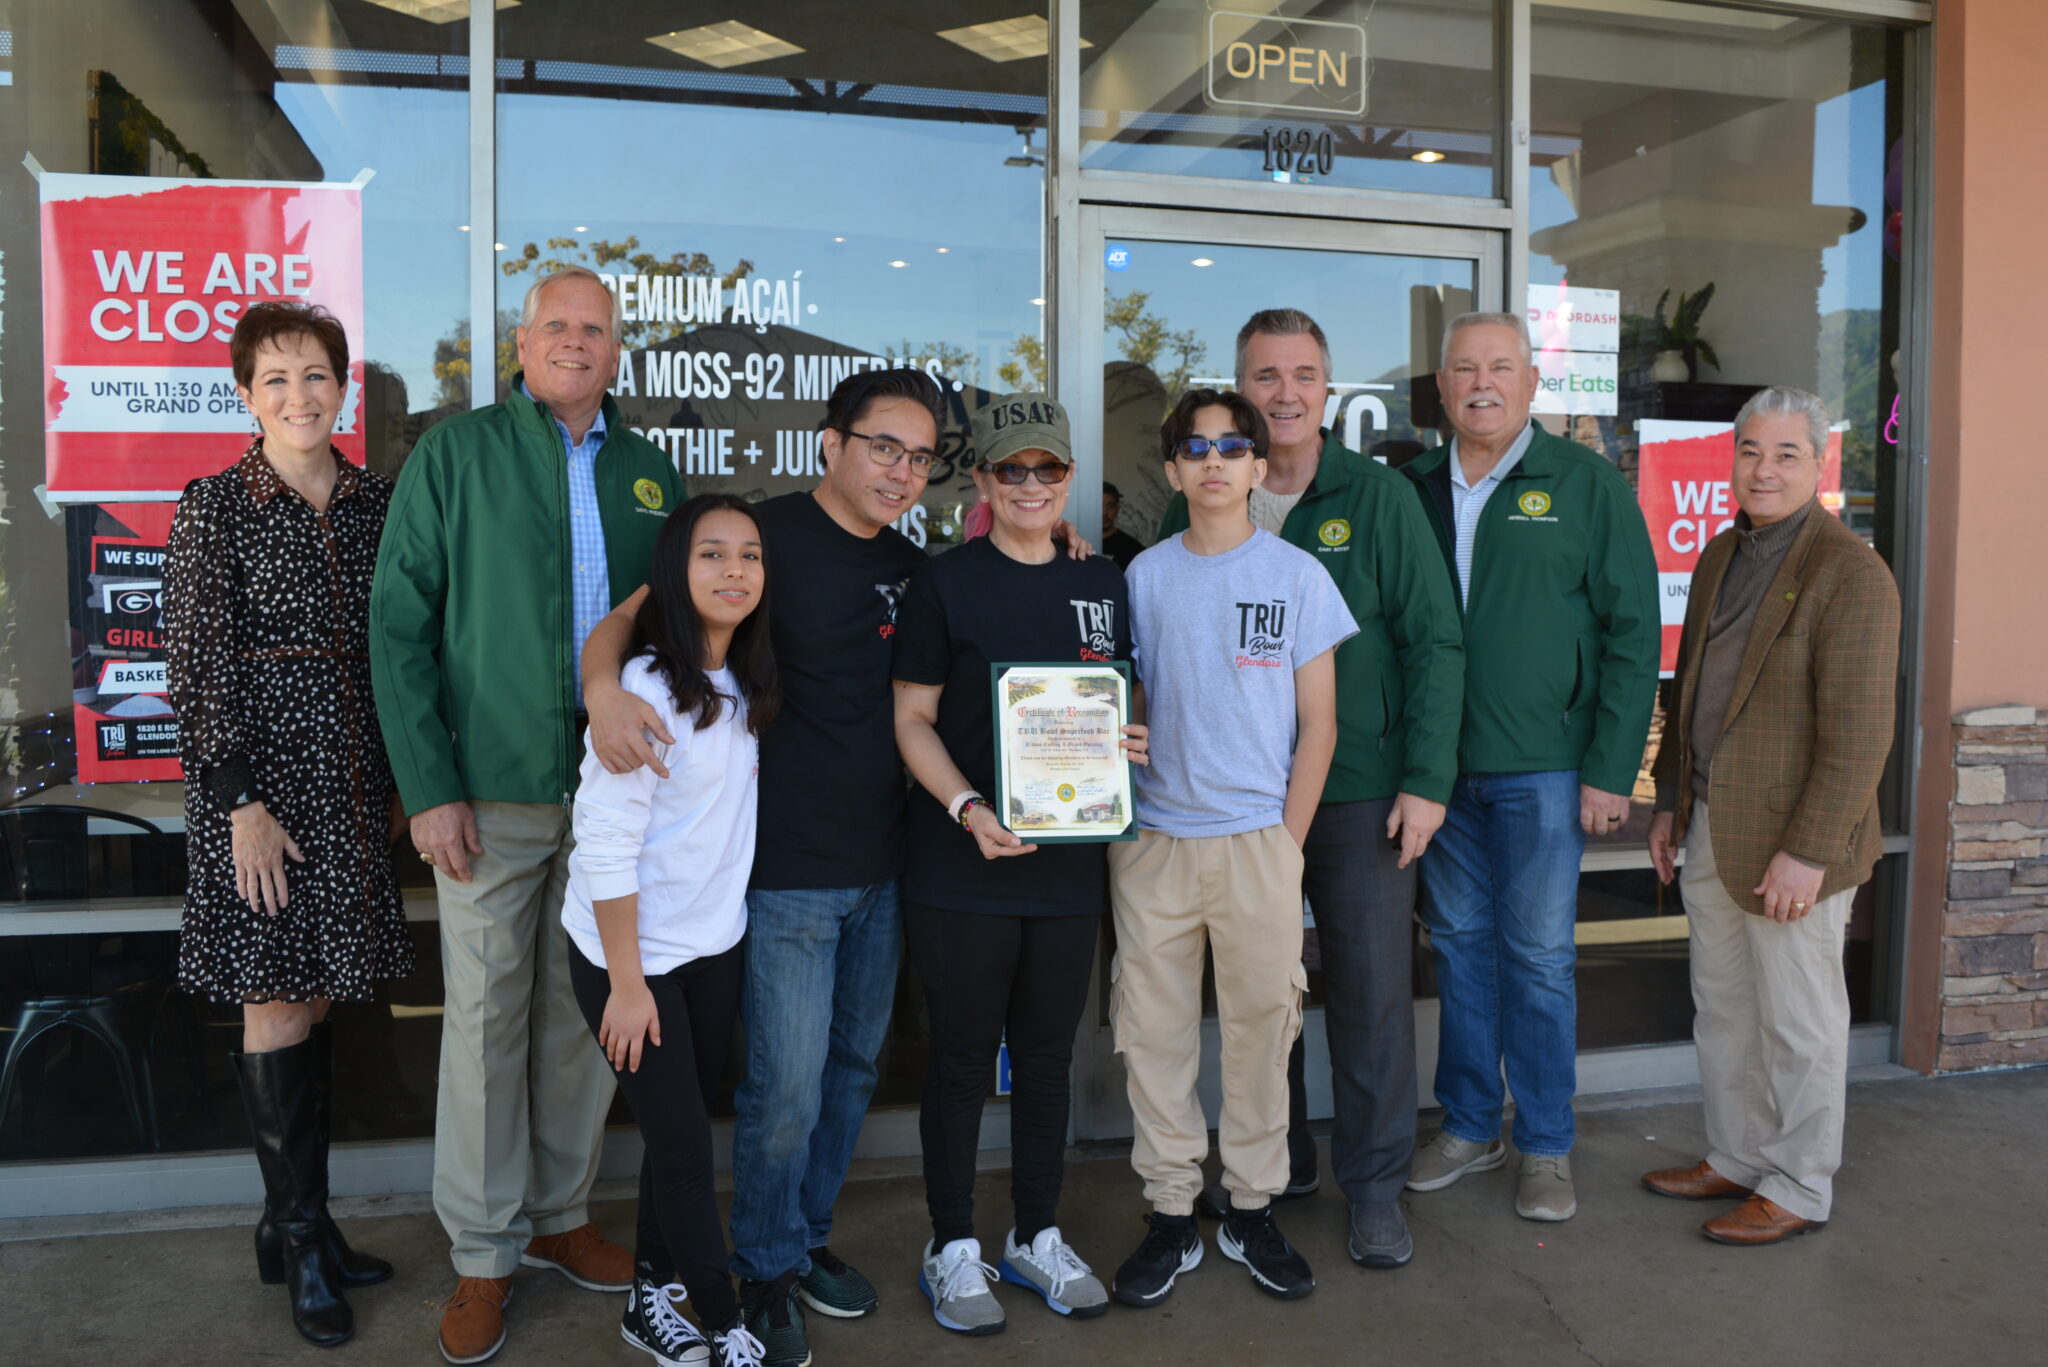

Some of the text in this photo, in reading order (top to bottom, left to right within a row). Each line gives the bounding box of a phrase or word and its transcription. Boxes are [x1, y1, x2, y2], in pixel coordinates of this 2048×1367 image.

[1227, 42, 1347, 87] OPEN
[1263, 126, 1335, 175] 1820
[1108, 251, 1128, 262] ADT
[92, 250, 311, 296] WE ARE
[731, 270, 803, 334] AÇAÍ
[646, 350, 784, 400] MOSS-92
[1569, 373, 1616, 393] Eats
[91, 381, 149, 397] UNTIL
[154, 382, 202, 397] 11:30
[127, 398, 251, 414] GRAND OPE
[1671, 480, 1731, 515] WE
[105, 550, 131, 564] WE
[106, 628, 164, 648] GIRL
[115, 670, 167, 682] BASKE
